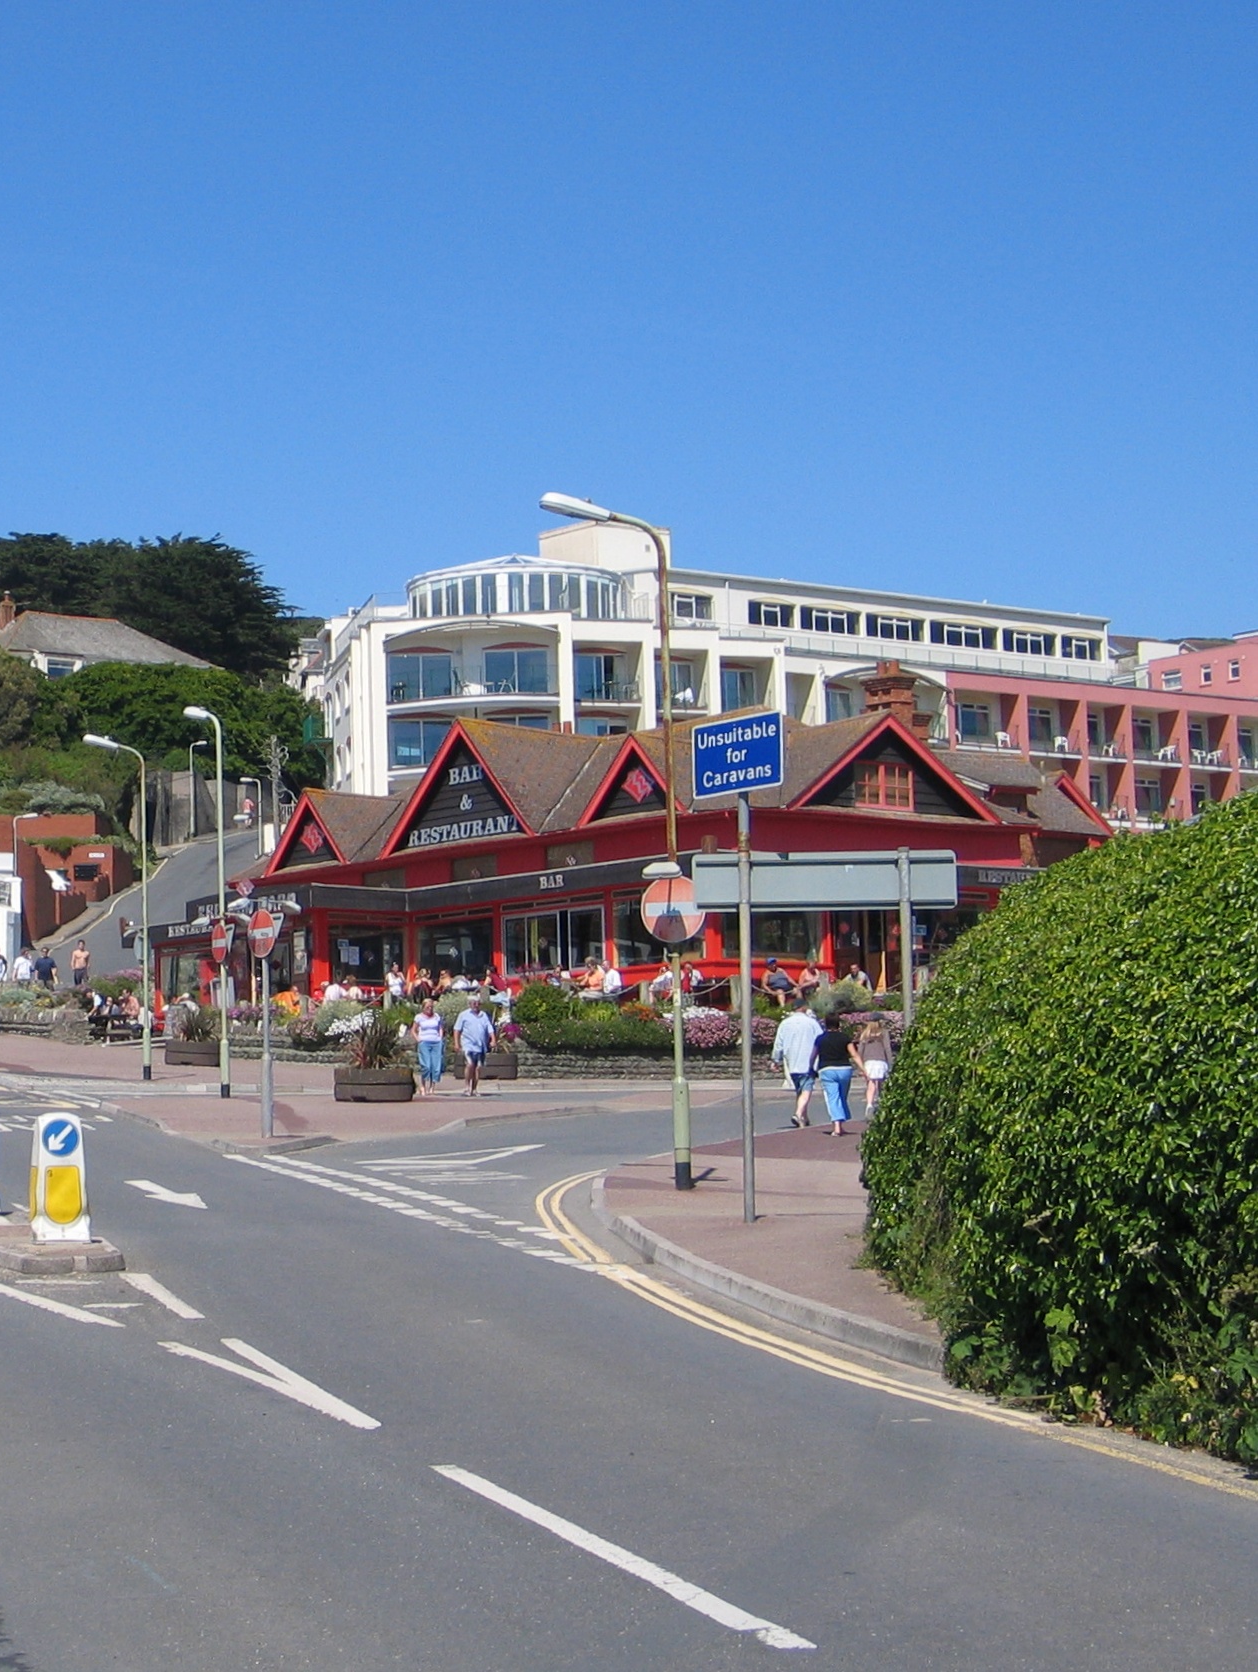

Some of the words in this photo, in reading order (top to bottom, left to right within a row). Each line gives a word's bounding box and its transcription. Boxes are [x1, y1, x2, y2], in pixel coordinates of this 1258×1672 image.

[697, 721, 777, 749] Unsuitable
[726, 747, 748, 764] for
[448, 764, 484, 786] BAR
[703, 764, 772, 788] Caravans
[460, 793, 473, 811] &
[408, 814, 520, 847] RESTAURANT
[539, 874, 565, 890] BAR
